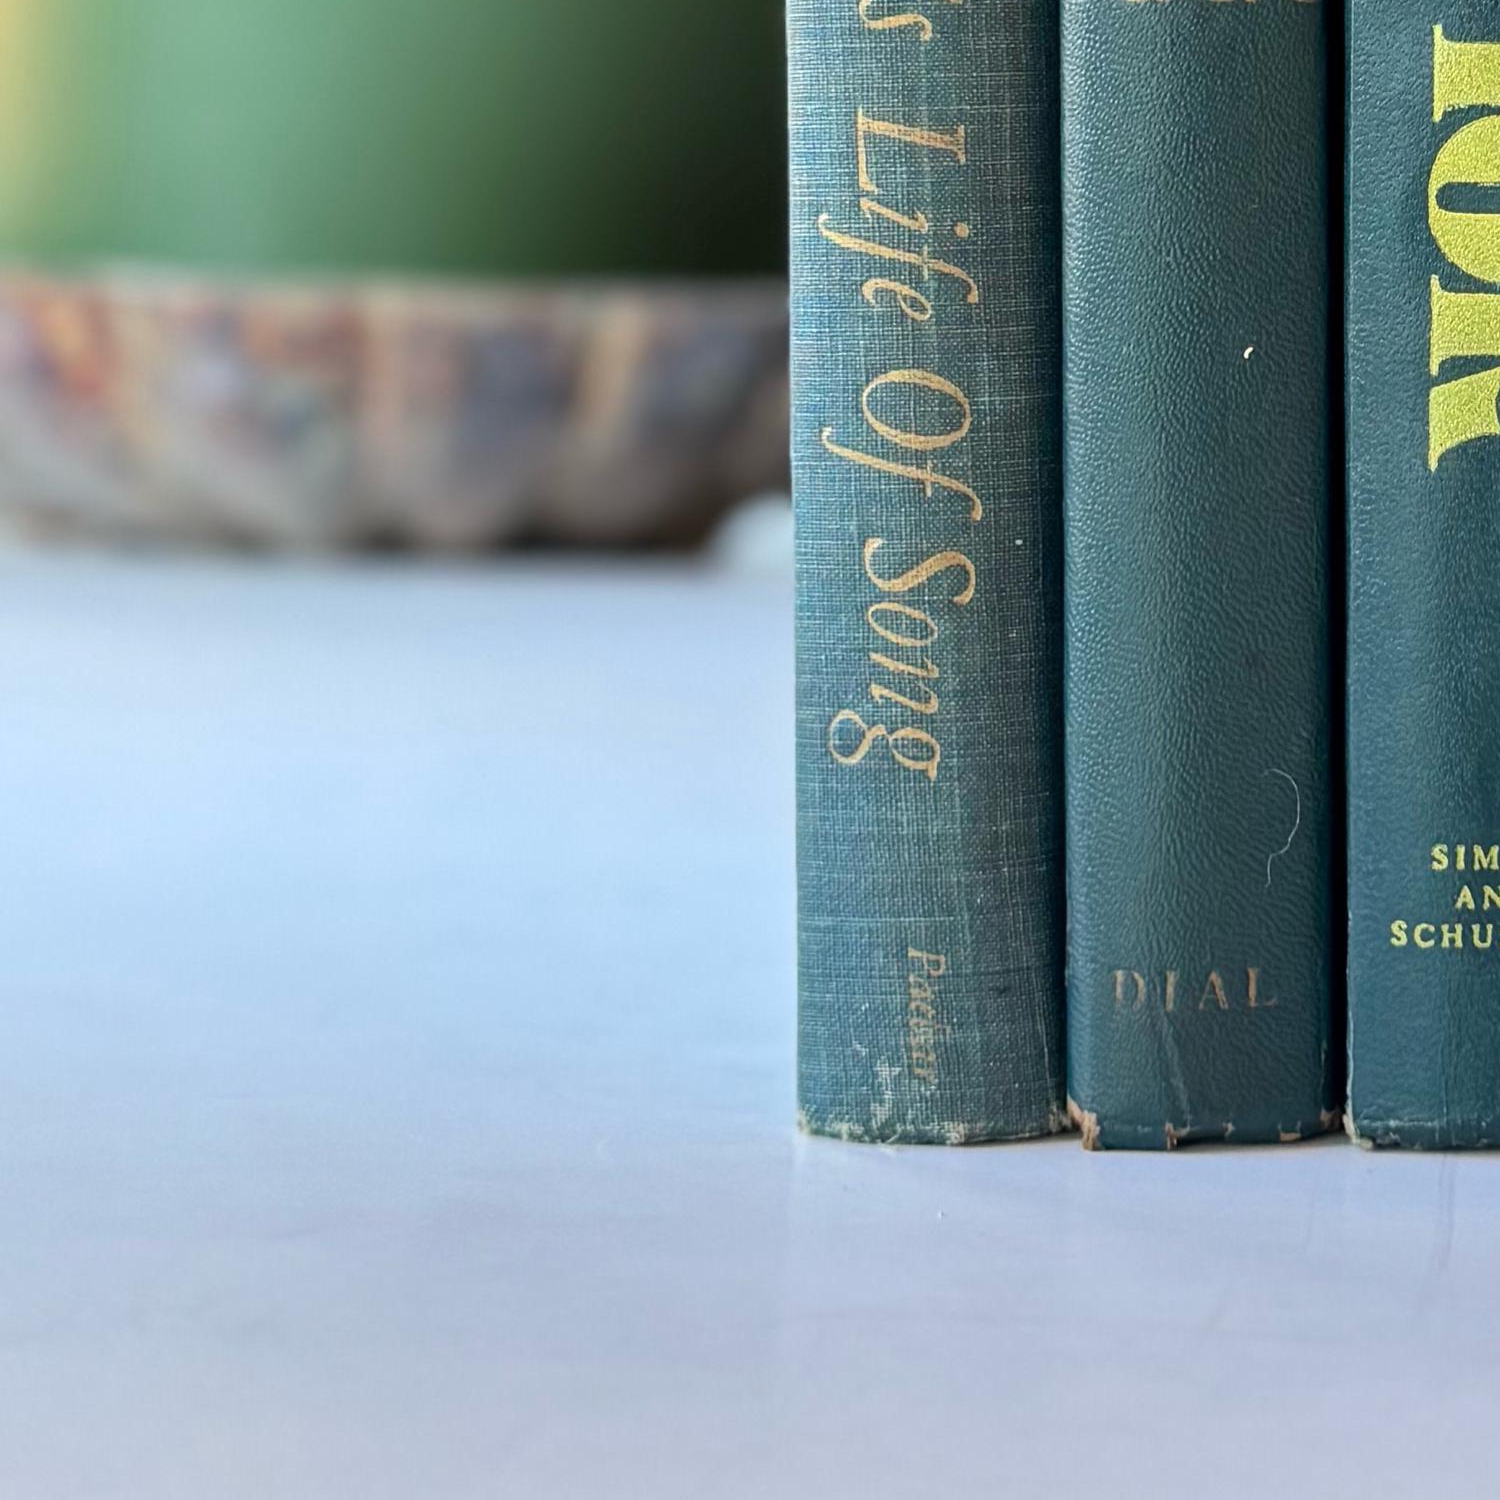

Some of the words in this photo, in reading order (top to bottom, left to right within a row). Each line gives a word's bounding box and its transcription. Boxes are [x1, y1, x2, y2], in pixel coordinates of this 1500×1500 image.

[816, 106, 978, 323] Life
[820, 369, 982, 522] Of
[825, 536, 976, 783] Song
[1111, 966, 1279, 1013] DIAL
